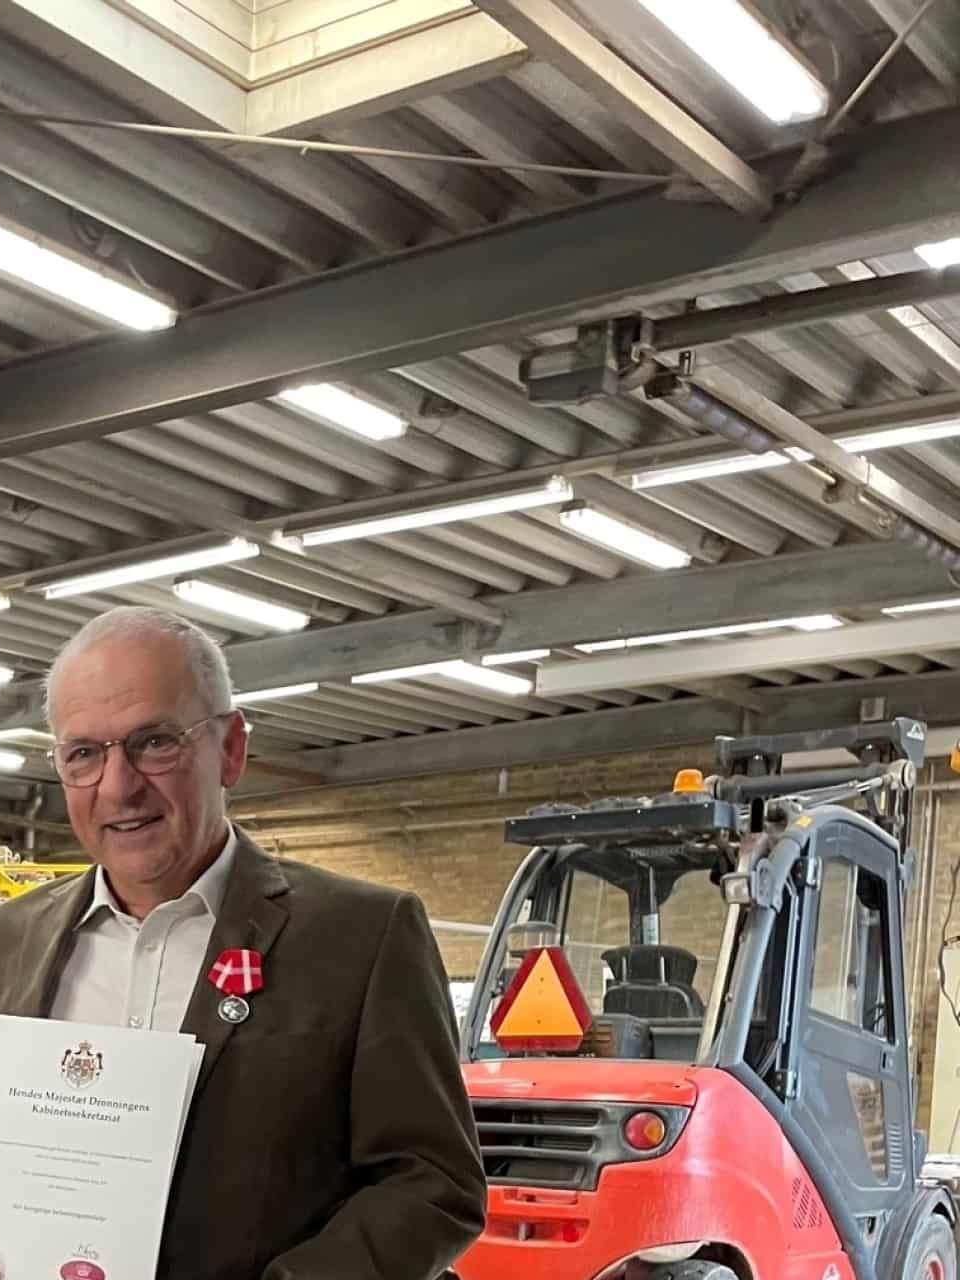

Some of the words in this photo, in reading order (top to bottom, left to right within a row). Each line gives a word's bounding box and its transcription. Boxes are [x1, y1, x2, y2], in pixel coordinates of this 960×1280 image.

[8, 1087, 43, 1099] Hendes
[46, 1091, 87, 1104] Majestæt
[89, 1096, 150, 1112] Dronningens
